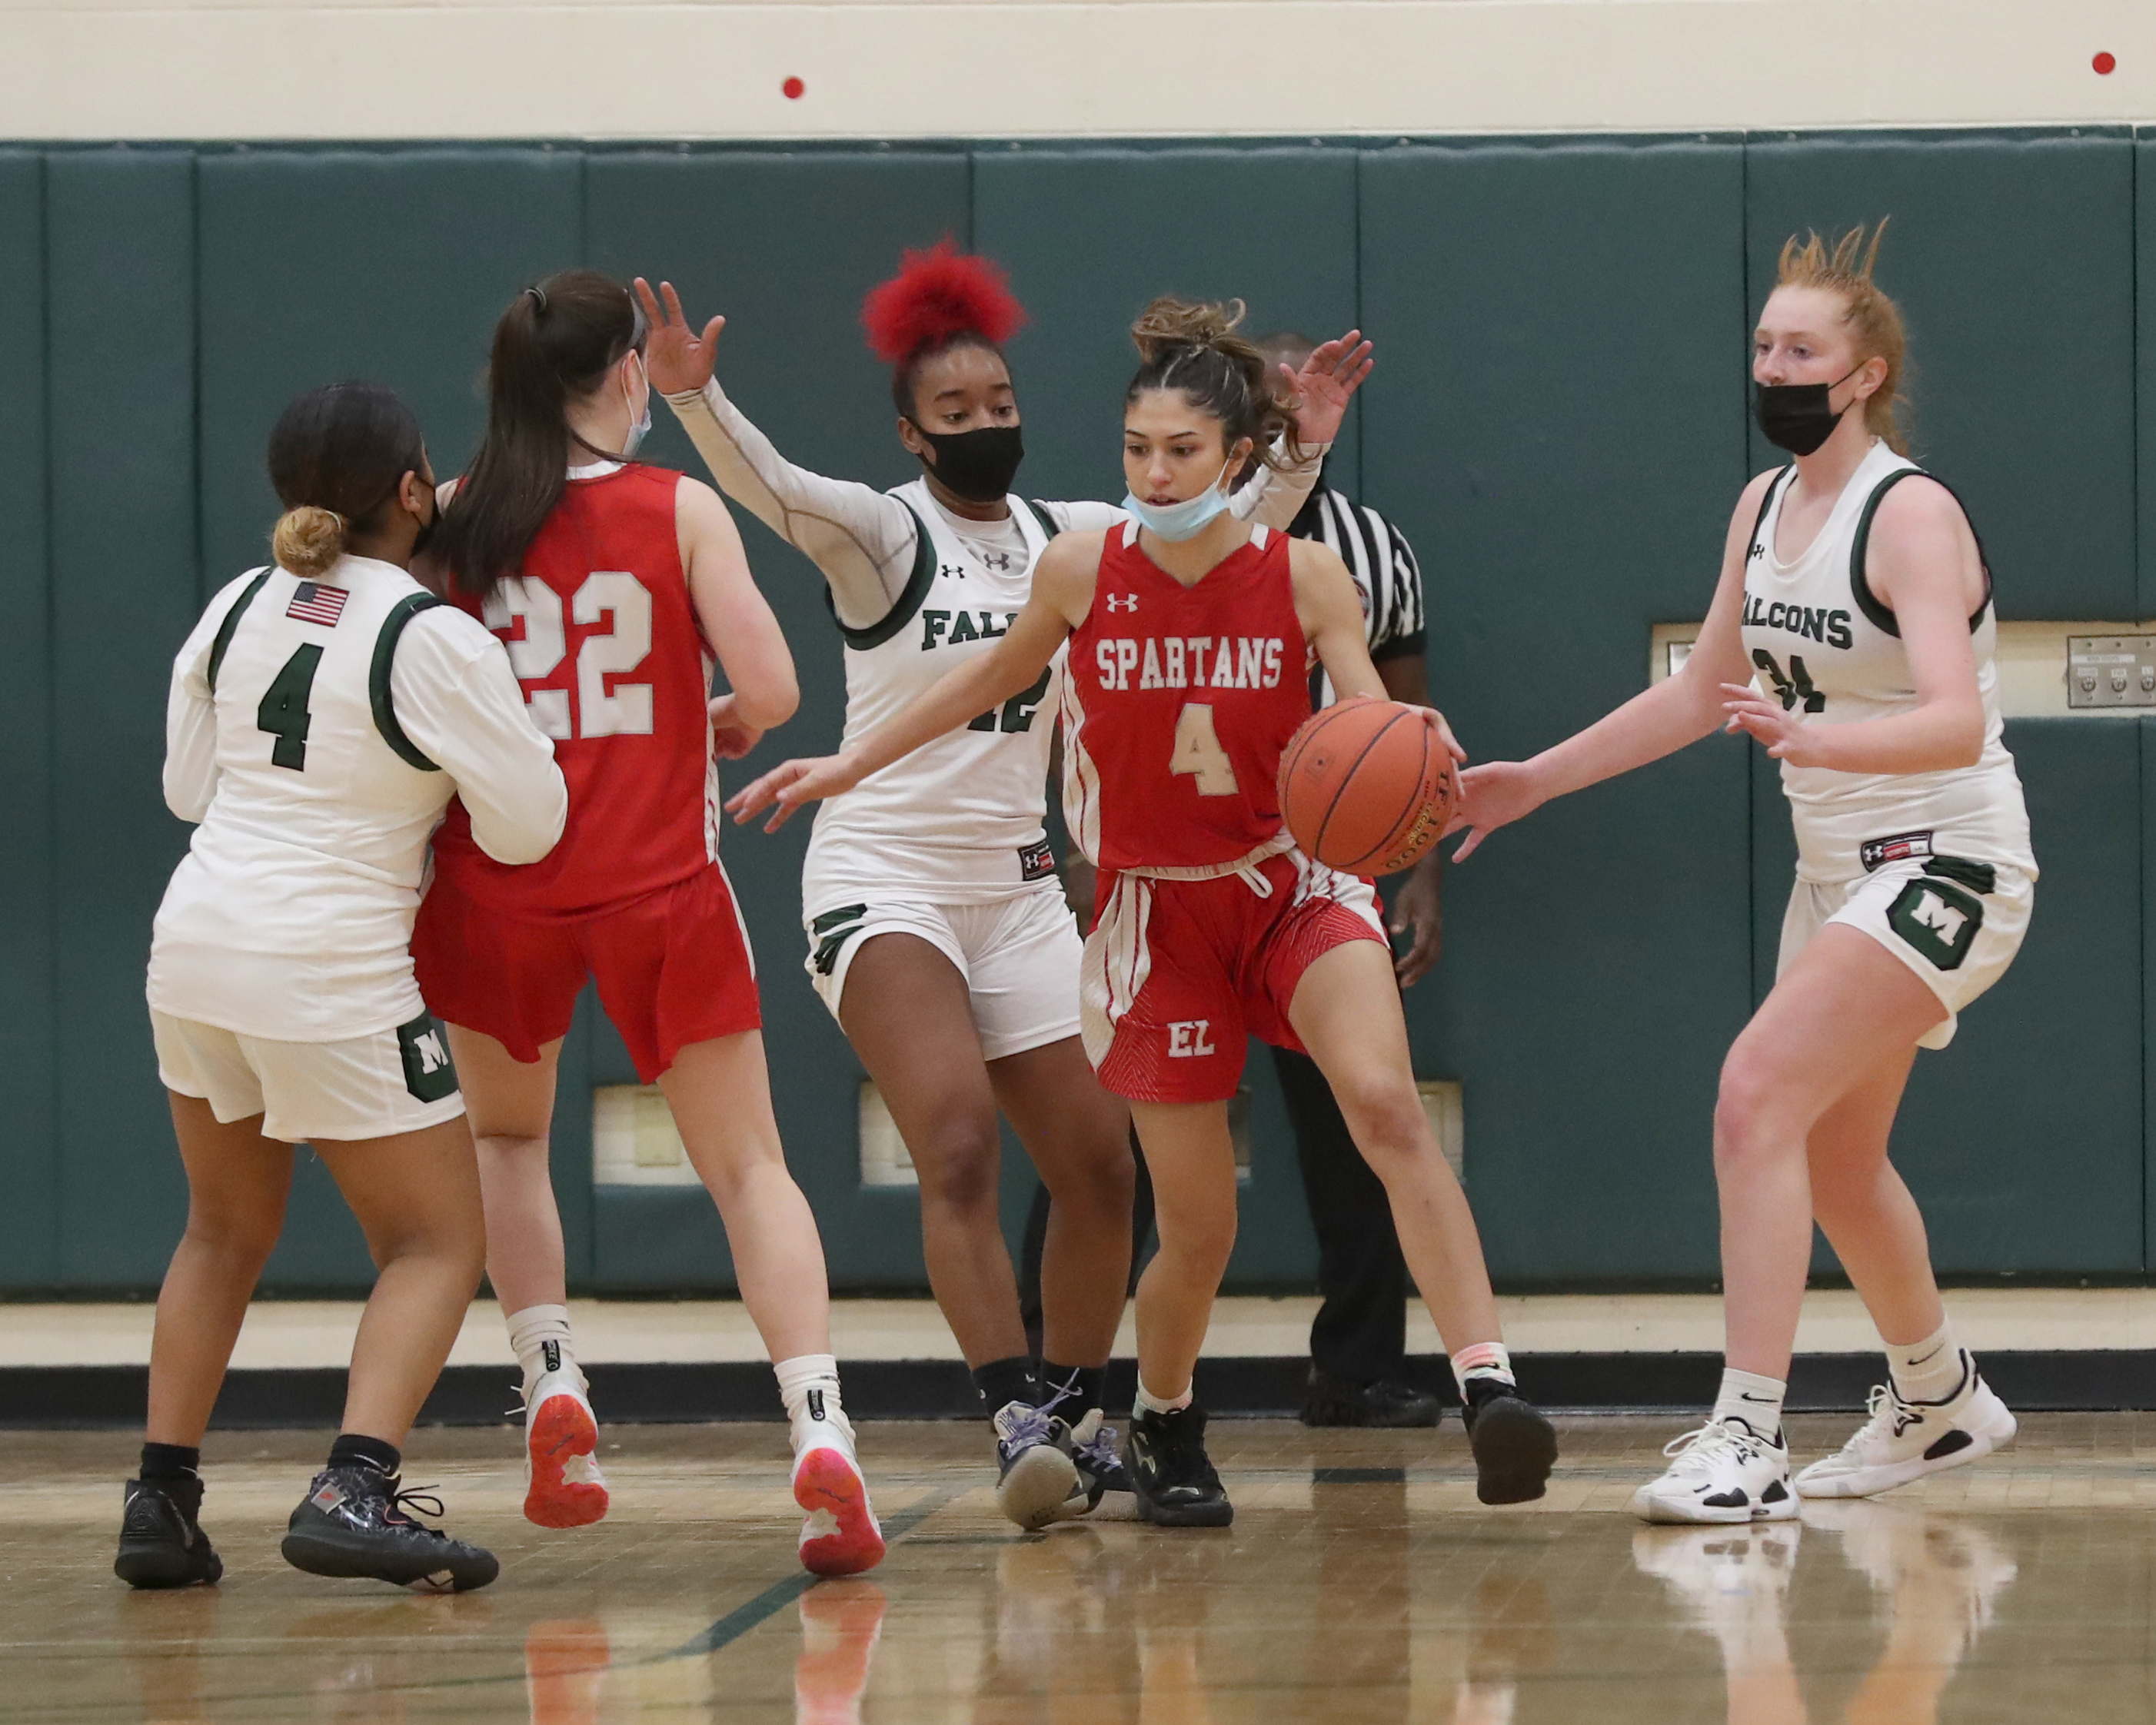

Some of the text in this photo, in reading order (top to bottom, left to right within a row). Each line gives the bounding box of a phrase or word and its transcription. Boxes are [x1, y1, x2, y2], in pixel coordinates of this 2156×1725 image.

[1742, 590, 1853, 650] ALCONS
[481, 572, 654, 740] 22
[1096, 636, 1283, 690] SPARTANS
[258, 643, 324, 772] 4
[1169, 703, 1239, 796] 4
[1911, 889, 1968, 946] M
[414, 1029, 449, 1075] M
[1167, 1019, 1215, 1058] EL
